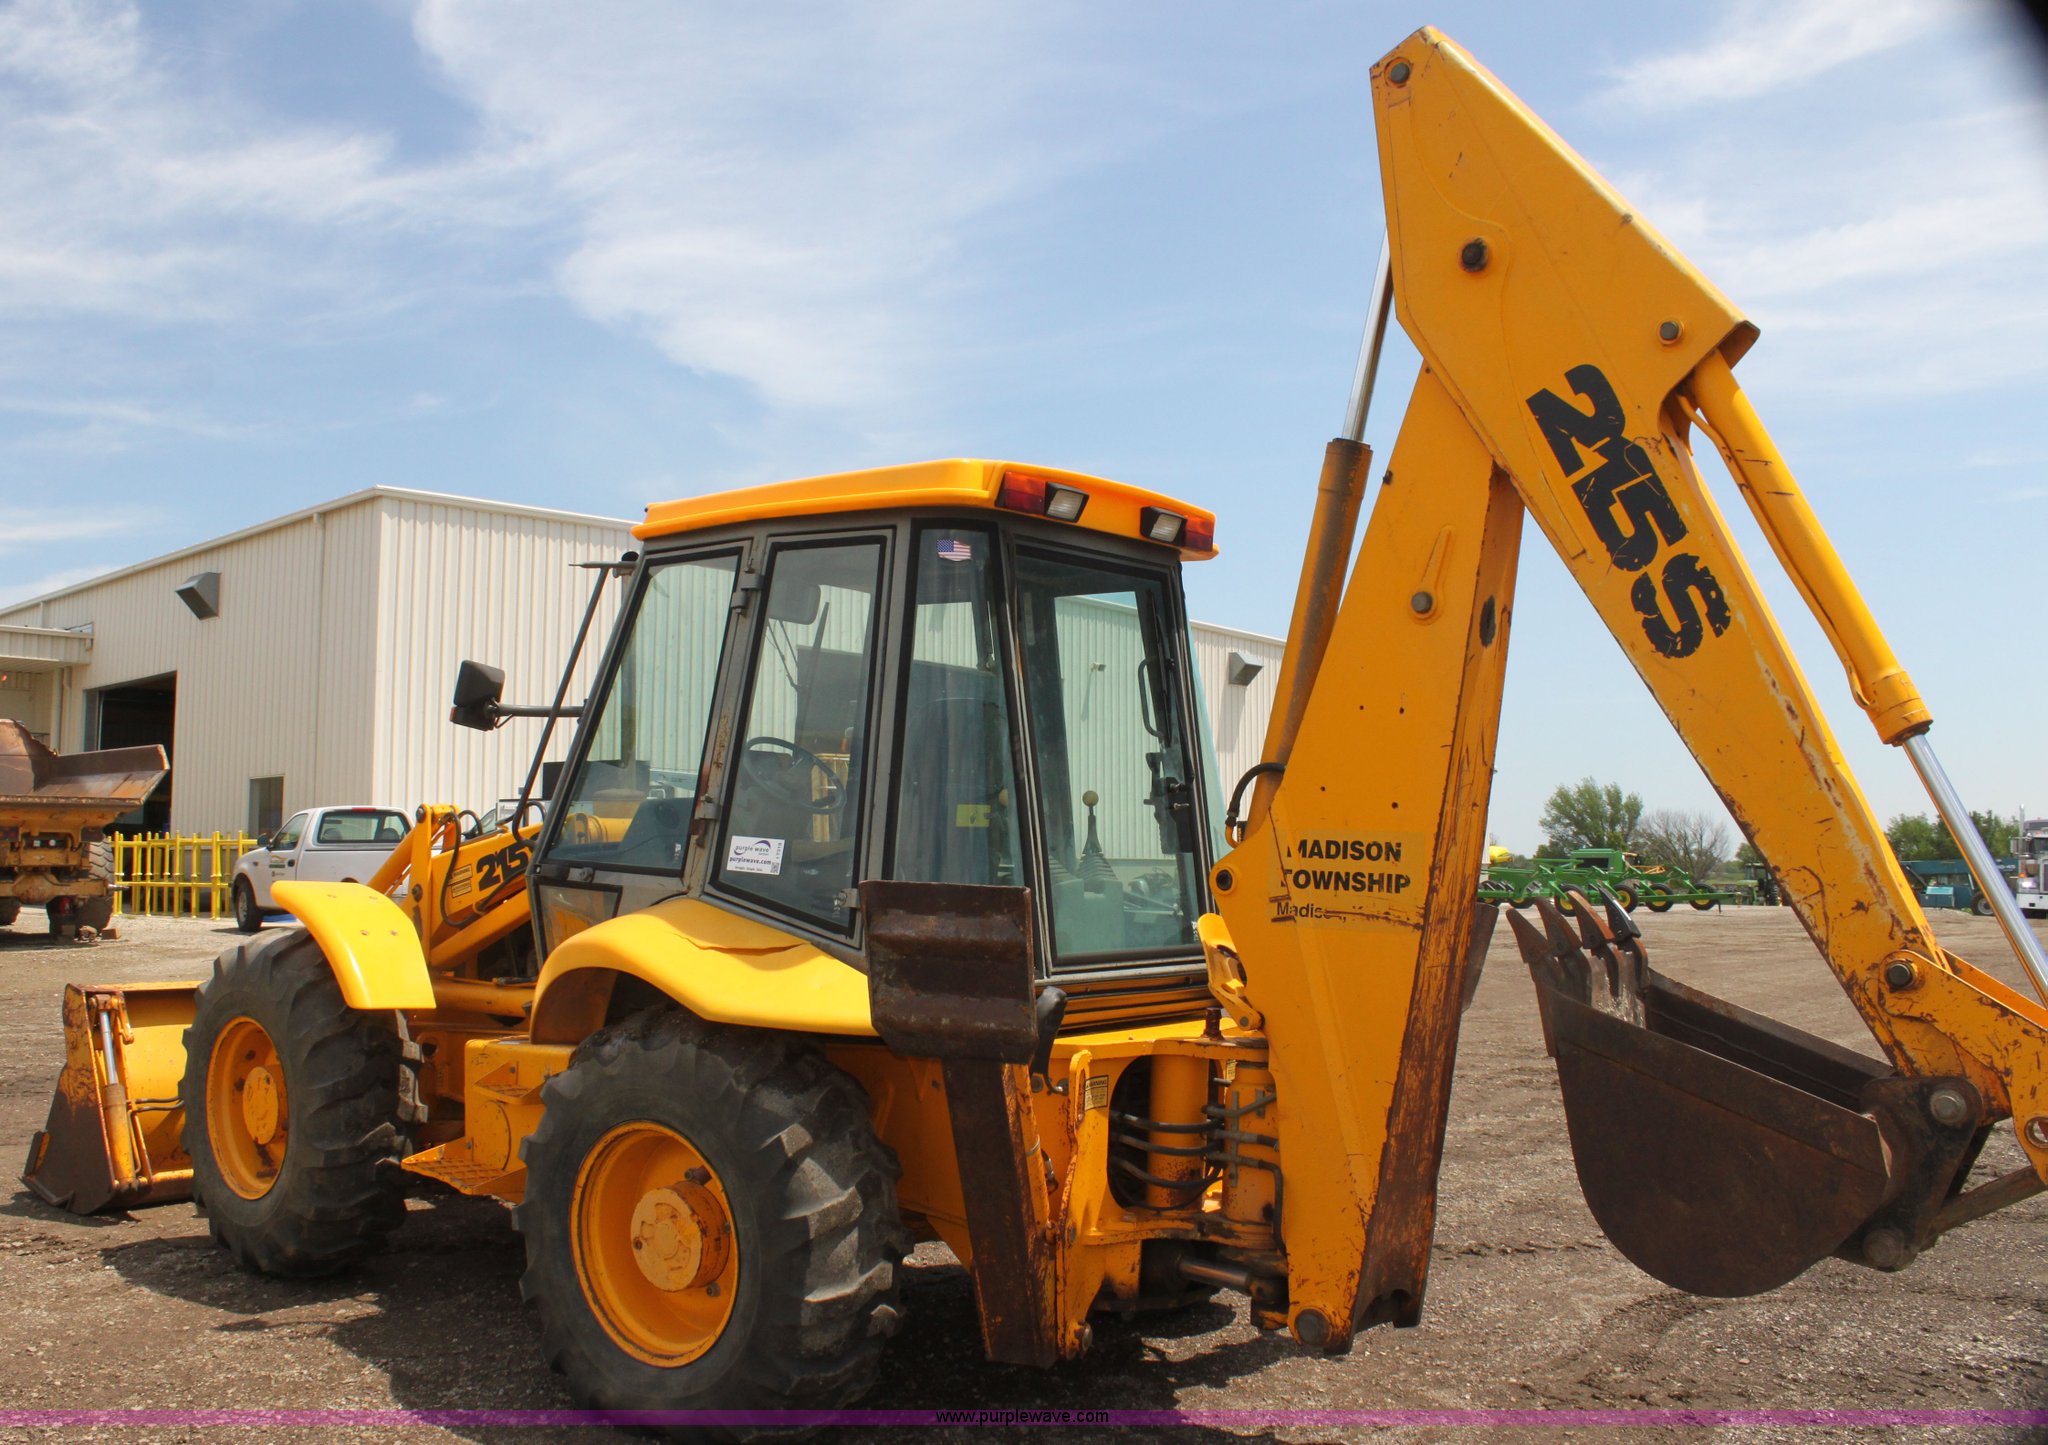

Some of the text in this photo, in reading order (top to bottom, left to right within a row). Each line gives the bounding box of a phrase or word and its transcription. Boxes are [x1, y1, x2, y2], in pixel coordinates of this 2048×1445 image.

[1526, 364, 1732, 659] 215S
[476, 834, 538, 891] 215
[729, 856, 771, 866] purplewave.com
[1286, 840, 1402, 862] MADISON
